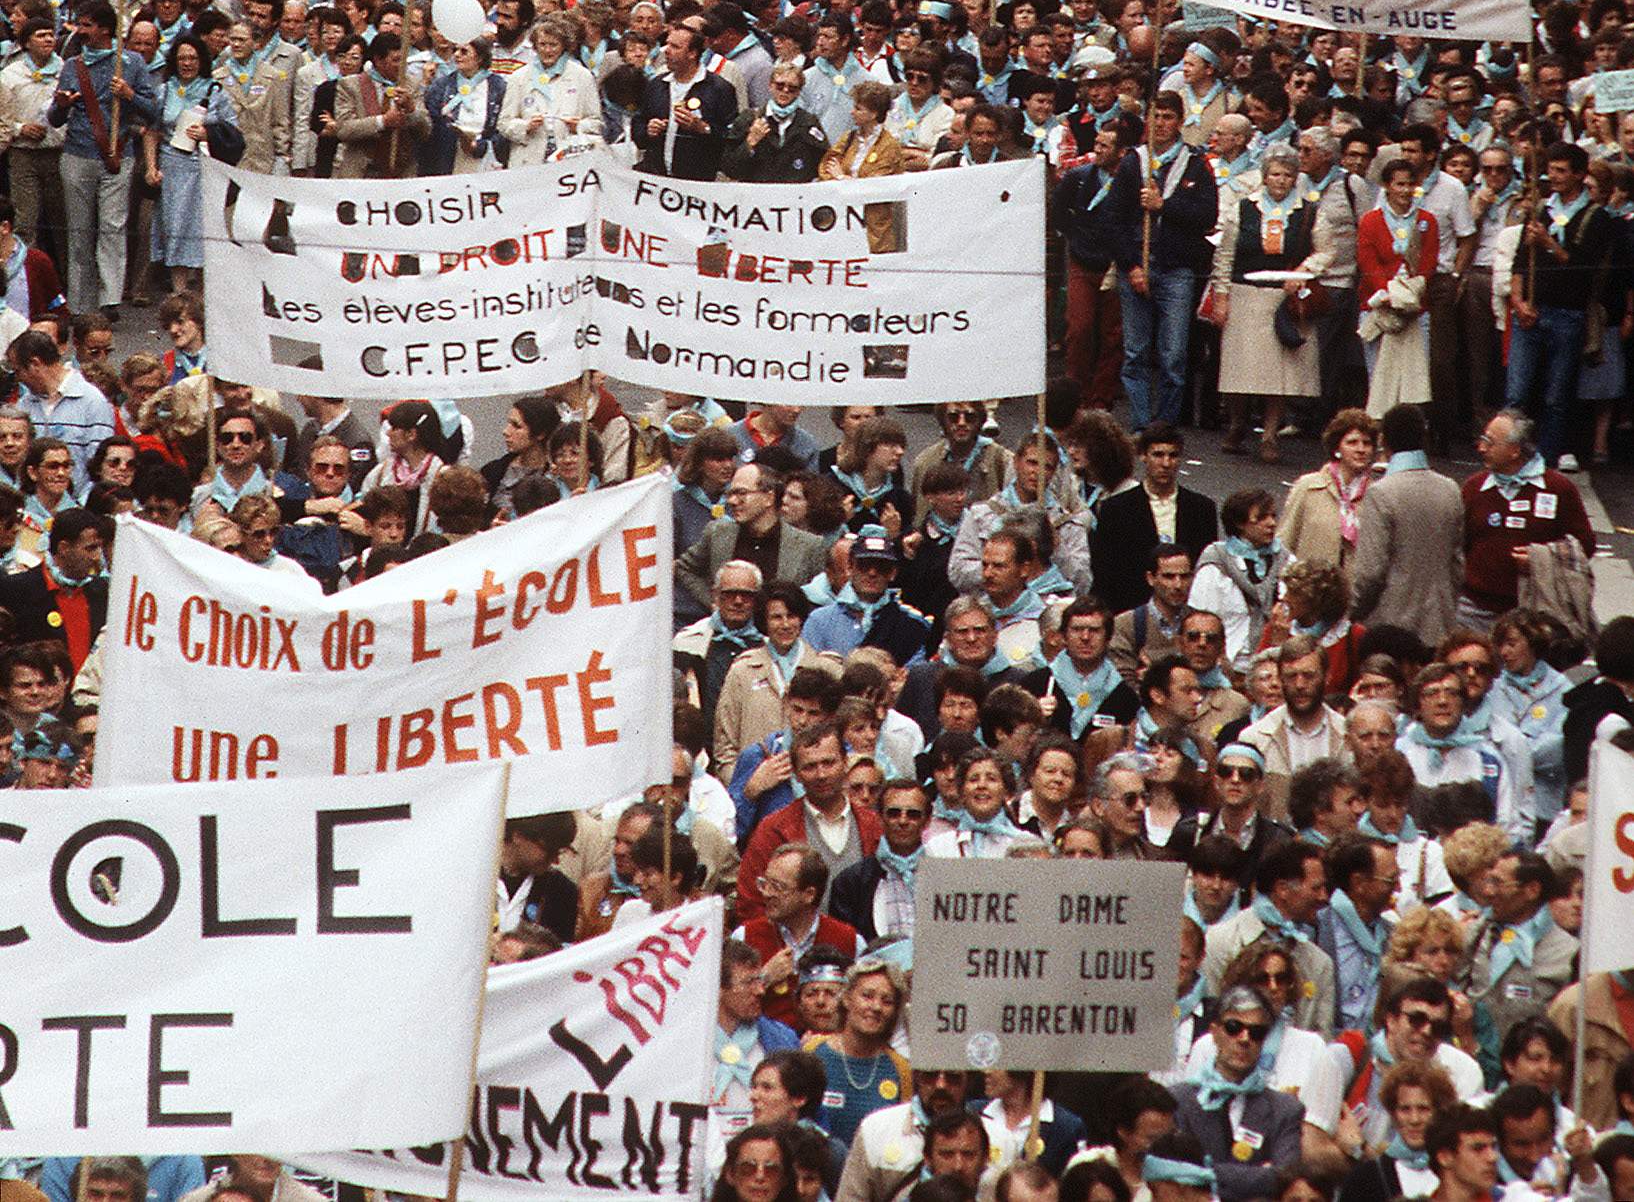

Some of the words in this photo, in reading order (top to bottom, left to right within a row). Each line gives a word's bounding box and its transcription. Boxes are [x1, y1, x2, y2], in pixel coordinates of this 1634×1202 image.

[557, 168, 602, 198] SA
[634, 178, 868, 235] FORMATION
[437, 228, 555, 276] DROIT
[600, 219, 669, 269] UNE
[656, 294, 685, 319] et
[694, 290, 741, 327] les
[754, 297, 971, 335] formateurs
[625, 325, 850, 385] Normandie
[177, 594, 301, 673] Choix
[321, 610, 376, 671] de
[410, 523, 660, 663] L'ÉCOLE
[172, 725, 280, 784] une
[332, 649, 620, 776] LIBERTÉ
[933, 893, 1018, 923] NOTRE
[1058, 894, 1129, 925] DAME
[966, 948, 1048, 979] SAINT
[1079, 950, 1155, 981] LOUIS
[1001, 1003, 1137, 1035] BARENTON
